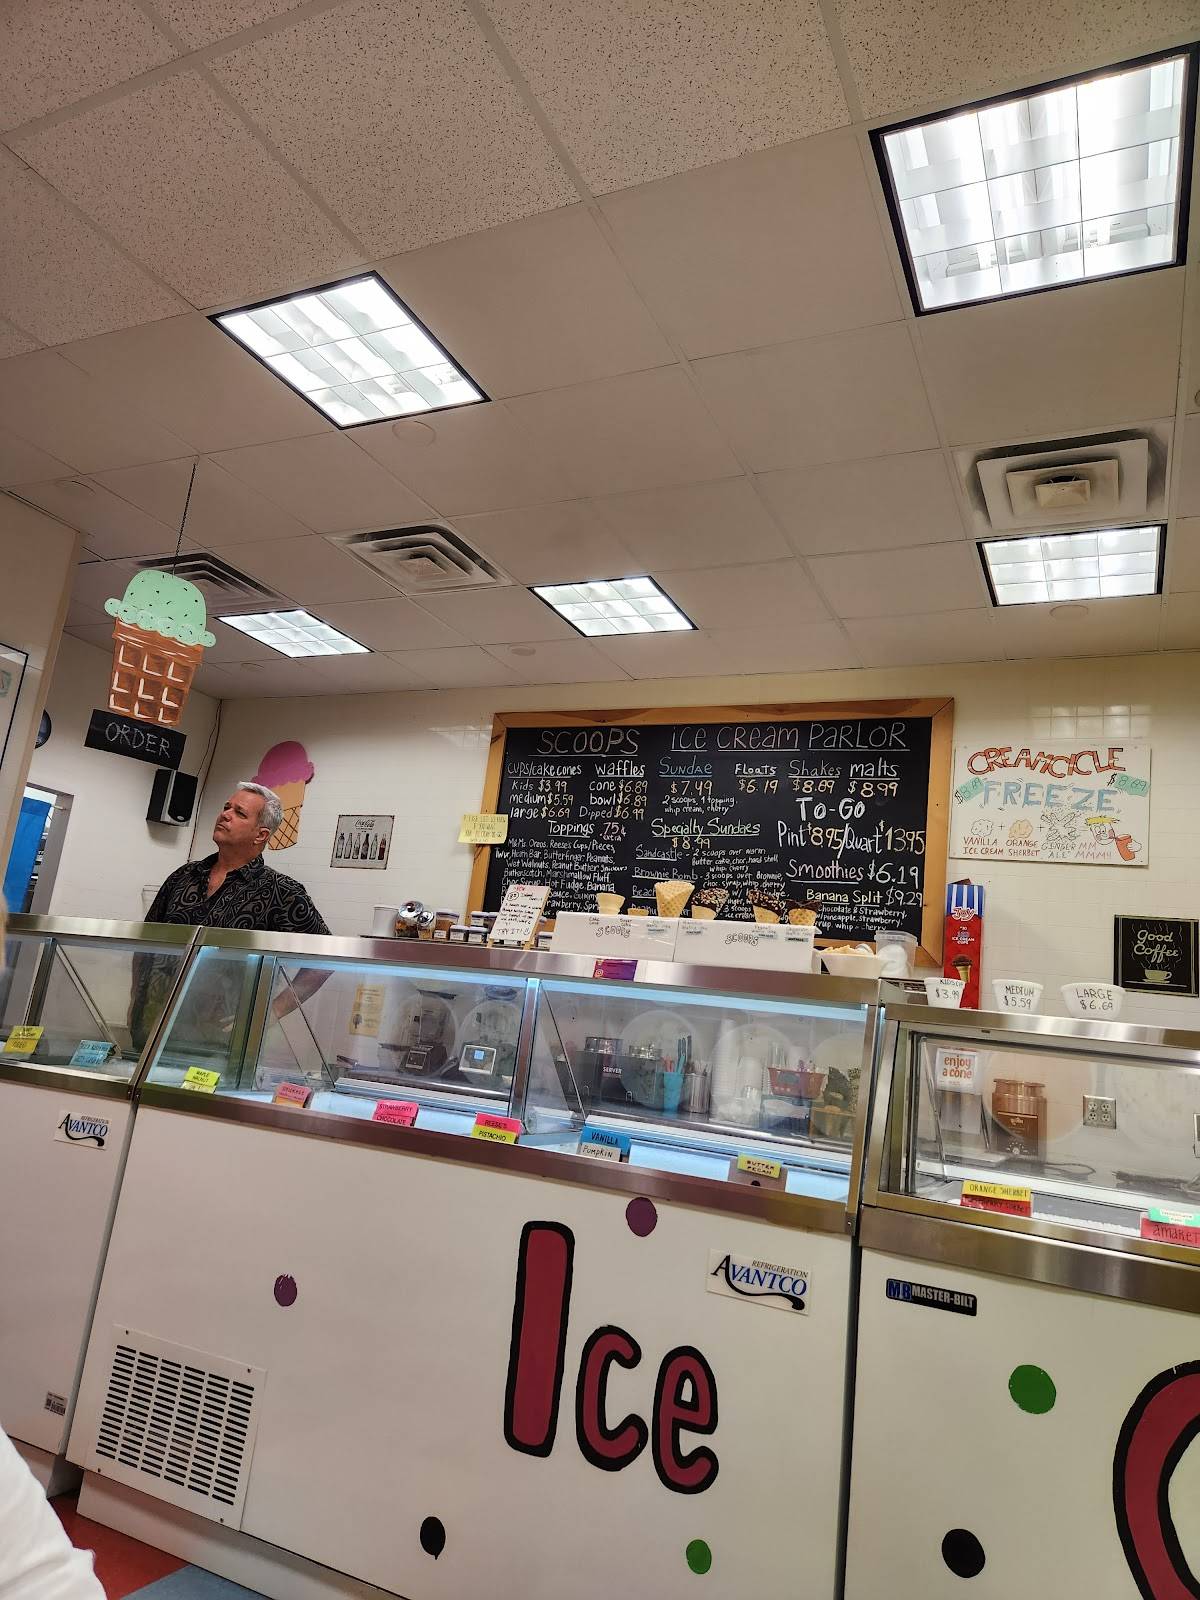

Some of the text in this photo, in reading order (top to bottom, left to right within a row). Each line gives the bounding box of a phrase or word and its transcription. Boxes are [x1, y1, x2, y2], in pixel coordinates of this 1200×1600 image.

[105, 721, 171, 758] ORDER
[537, 727, 641, 755] SCOOPS
[788, 759, 842, 776] Shakes
[966, 747, 1127, 778] CREAMCICLE
[618, 779, 648, 794] $6.89
[670, 780, 713, 796] $7.49
[738, 778, 779, 794] $6.19
[847, 780, 899, 797] $8.99
[589, 792, 616, 806] bowl
[662, 794, 670, 805] 2
[983, 780, 1118, 812] FREEZE
[510, 805, 571, 820] large $6.69
[578, 805, 614, 820] Dipped
[664, 804, 681, 816] whip
[547, 819, 596, 837] Toppings
[650, 816, 761, 839] Specialty Sundaes
[635, 843, 683, 859] Sandcastle
[963, 836, 998, 846] VANILLA
[1005, 839, 1039, 847] ORANGE
[1040, 841, 1076, 851] GINGER
[962, 846, 979, 855] ICE
[980, 847, 1004, 855] CREAM
[1008, 848, 1041, 857] SHERBET
[634, 866, 670, 879] Brownie
[672, 867, 699, 881] Bomb
[785, 858, 920, 889] Smoothies $6.19
[806, 885, 923, 908] Banana Split $9.29
[1137, 929, 1174, 944] Good
[1133, 943, 1179, 963] Coffee
[1005, 984, 1036, 997] MEDIUM
[1076, 987, 1113, 1001] LARGE
[1003, 995, 1032, 1009] $5.59
[944, 1055, 972, 1070] enjoy
[942, 1067, 972, 1079] a cone
[376, 1114, 407, 1125] CHOCOLATE
[478, 1130, 507, 1142] PISTACHIO
[591, 1131, 619, 1145] VANILLA
[969, 1183, 997, 1194] ORANGE
[752, 1259, 809, 1279] REFRIGERATION
[711, 1254, 808, 1311] AVANTCO
[887, 1280, 974, 1309] MB MASTER-BILT
[503, 1219, 720, 1495] Ice
